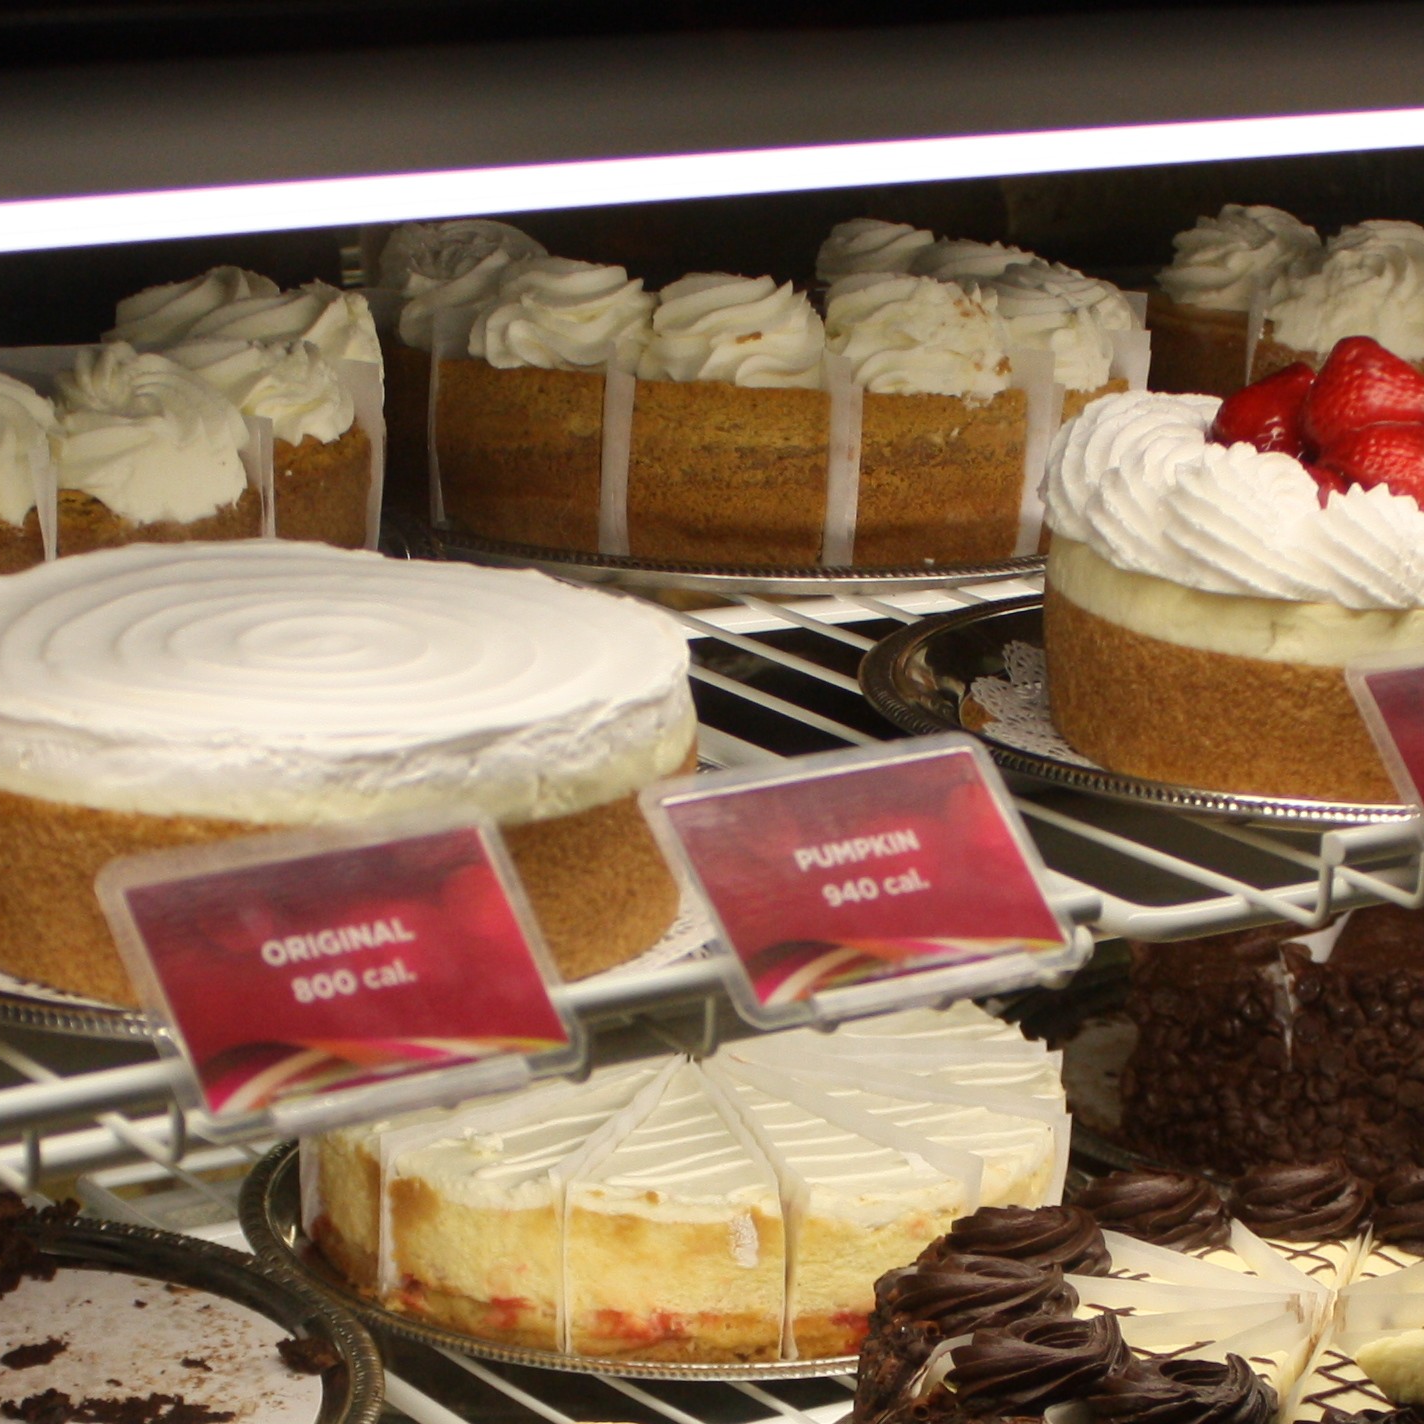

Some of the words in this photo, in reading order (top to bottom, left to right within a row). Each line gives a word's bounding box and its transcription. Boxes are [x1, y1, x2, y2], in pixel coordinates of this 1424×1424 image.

[793, 830, 922, 871] PUMPKIN
[823, 875, 877, 910] 940
[883, 869, 931, 898] cal.
[260, 917, 414, 968] ORIGINAL
[291, 966, 356, 1004] 800
[363, 957, 417, 991] cal.
